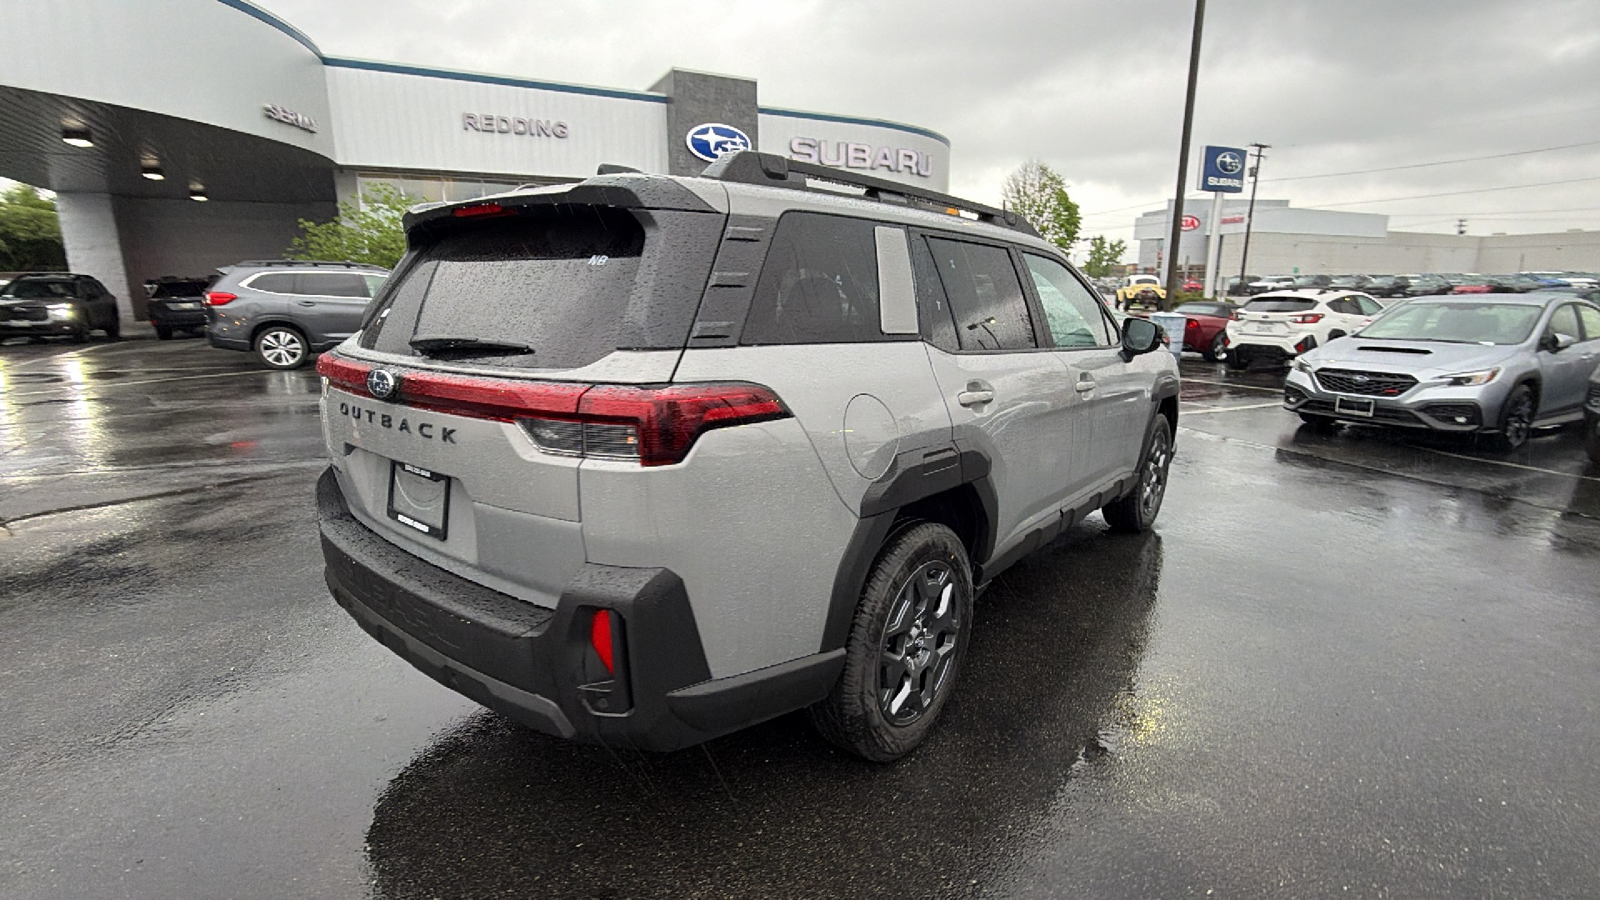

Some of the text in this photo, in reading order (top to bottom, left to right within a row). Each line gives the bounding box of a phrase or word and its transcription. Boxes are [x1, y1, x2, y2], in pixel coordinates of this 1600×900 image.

[462, 112, 569, 139] REDDING
[790, 137, 933, 178] SUBARU
[340, 402, 457, 444] OUTBACK
